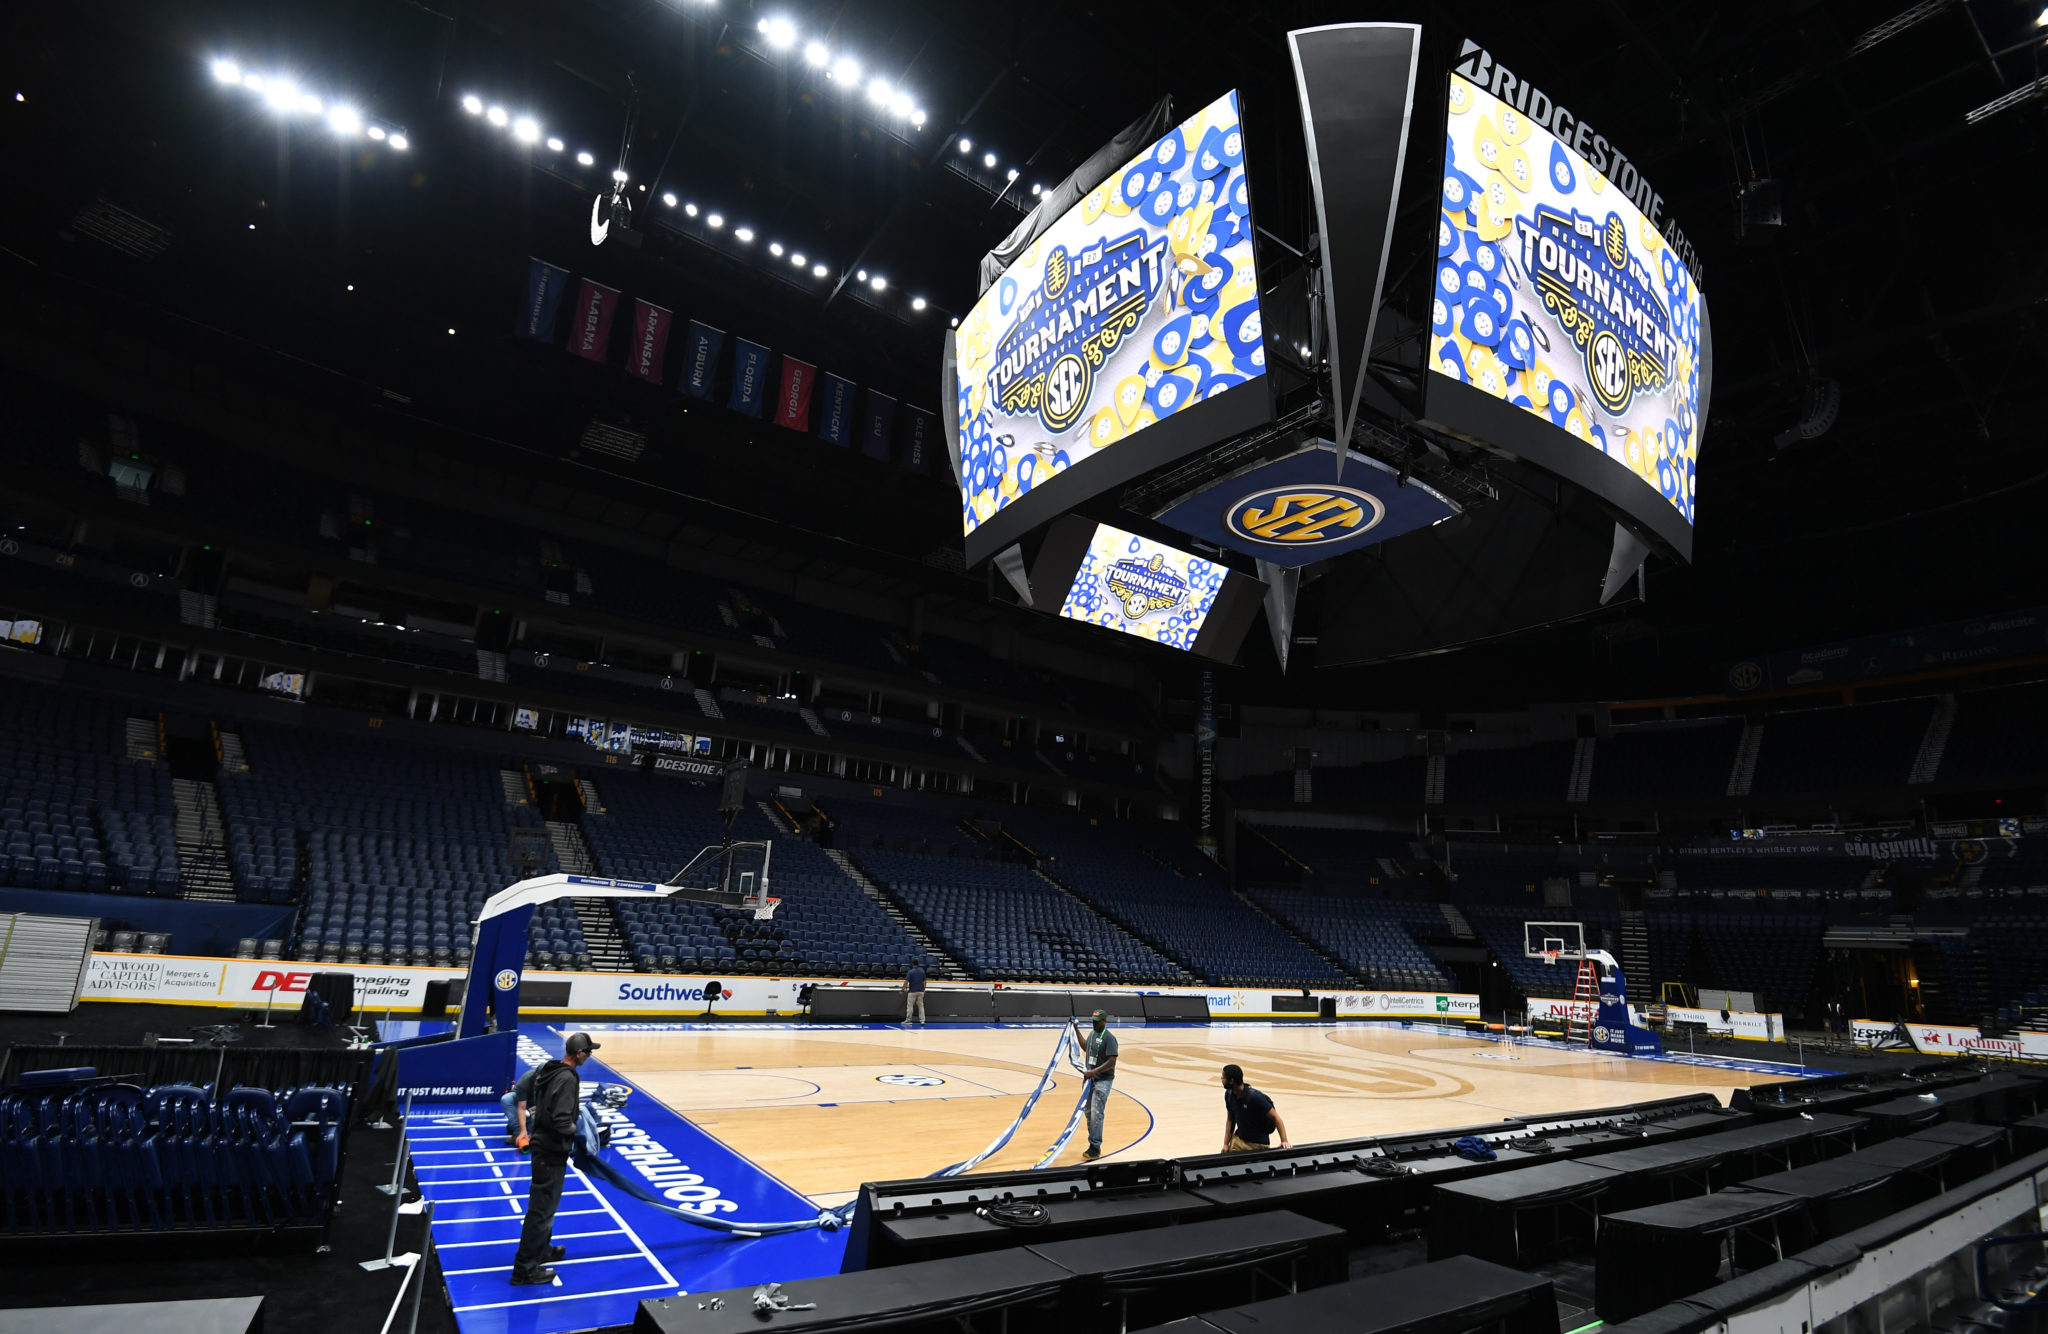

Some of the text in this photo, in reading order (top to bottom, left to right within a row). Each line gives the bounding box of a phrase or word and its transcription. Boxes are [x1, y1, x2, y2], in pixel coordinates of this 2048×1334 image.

[1455, 38, 1706, 283] BRIDGESTONE ARENA
[1552, 226, 1662, 323] MEN'S BASKETBALL
[1518, 220, 1677, 379] TOURNAMENT
[582, 290, 603, 351] ALABAMA
[988, 241, 1166, 404] TOURNAMENT
[1583, 299, 1640, 349] NASHVILLE
[639, 308, 659, 376] ARKANSAS
[1033, 323, 1095, 375] NASHVILLE
[692, 336, 709, 387] AUBURN
[1595, 336, 1625, 396] SEC
[741, 352, 757, 403] FLORIDA
[1048, 358, 1082, 415] SEC
[788, 369, 803, 418] GEORGIA
[830, 382, 845, 441] KENTUCKY
[873, 415, 883, 437] LSU
[912, 417, 925, 465] OLE MISS
[1242, 494, 1364, 541] SEC
[1107, 565, 1190, 604] TOURNAMENT
[1988, 616, 2037, 633] Allstate
[1800, 648, 1849, 661] Academy
[1733, 665, 1760, 689] SEC
[1201, 671, 1213, 830] VANDERBILT HEALTH
[632, 753, 715, 776] BDGESTONE
[1755, 846, 1798, 854] WHISKEY
[1800, 845, 1820, 853] ROW
[1844, 836, 1939, 861] SMASHVILLE
[89, 961, 160, 972] ENTWOOD
[100, 971, 157, 981] CAPITAL
[166, 970, 201, 979] Mergers
[88, 980, 156, 990] ADVISORS
[165, 979, 217, 988] Acquisitions
[252, 971, 313, 993] DE
[353, 975, 411, 986] maging
[497, 971, 516, 989] SEC
[618, 983, 706, 1001] Southwe
[1447, 1000, 1480, 1010] nterpr
[1550, 1004, 1599, 1018] NISS
[1948, 1033, 2025, 1051] Lochinvar
[397, 1088, 408, 1097] IT
[431, 1087, 465, 1096] MEANS
